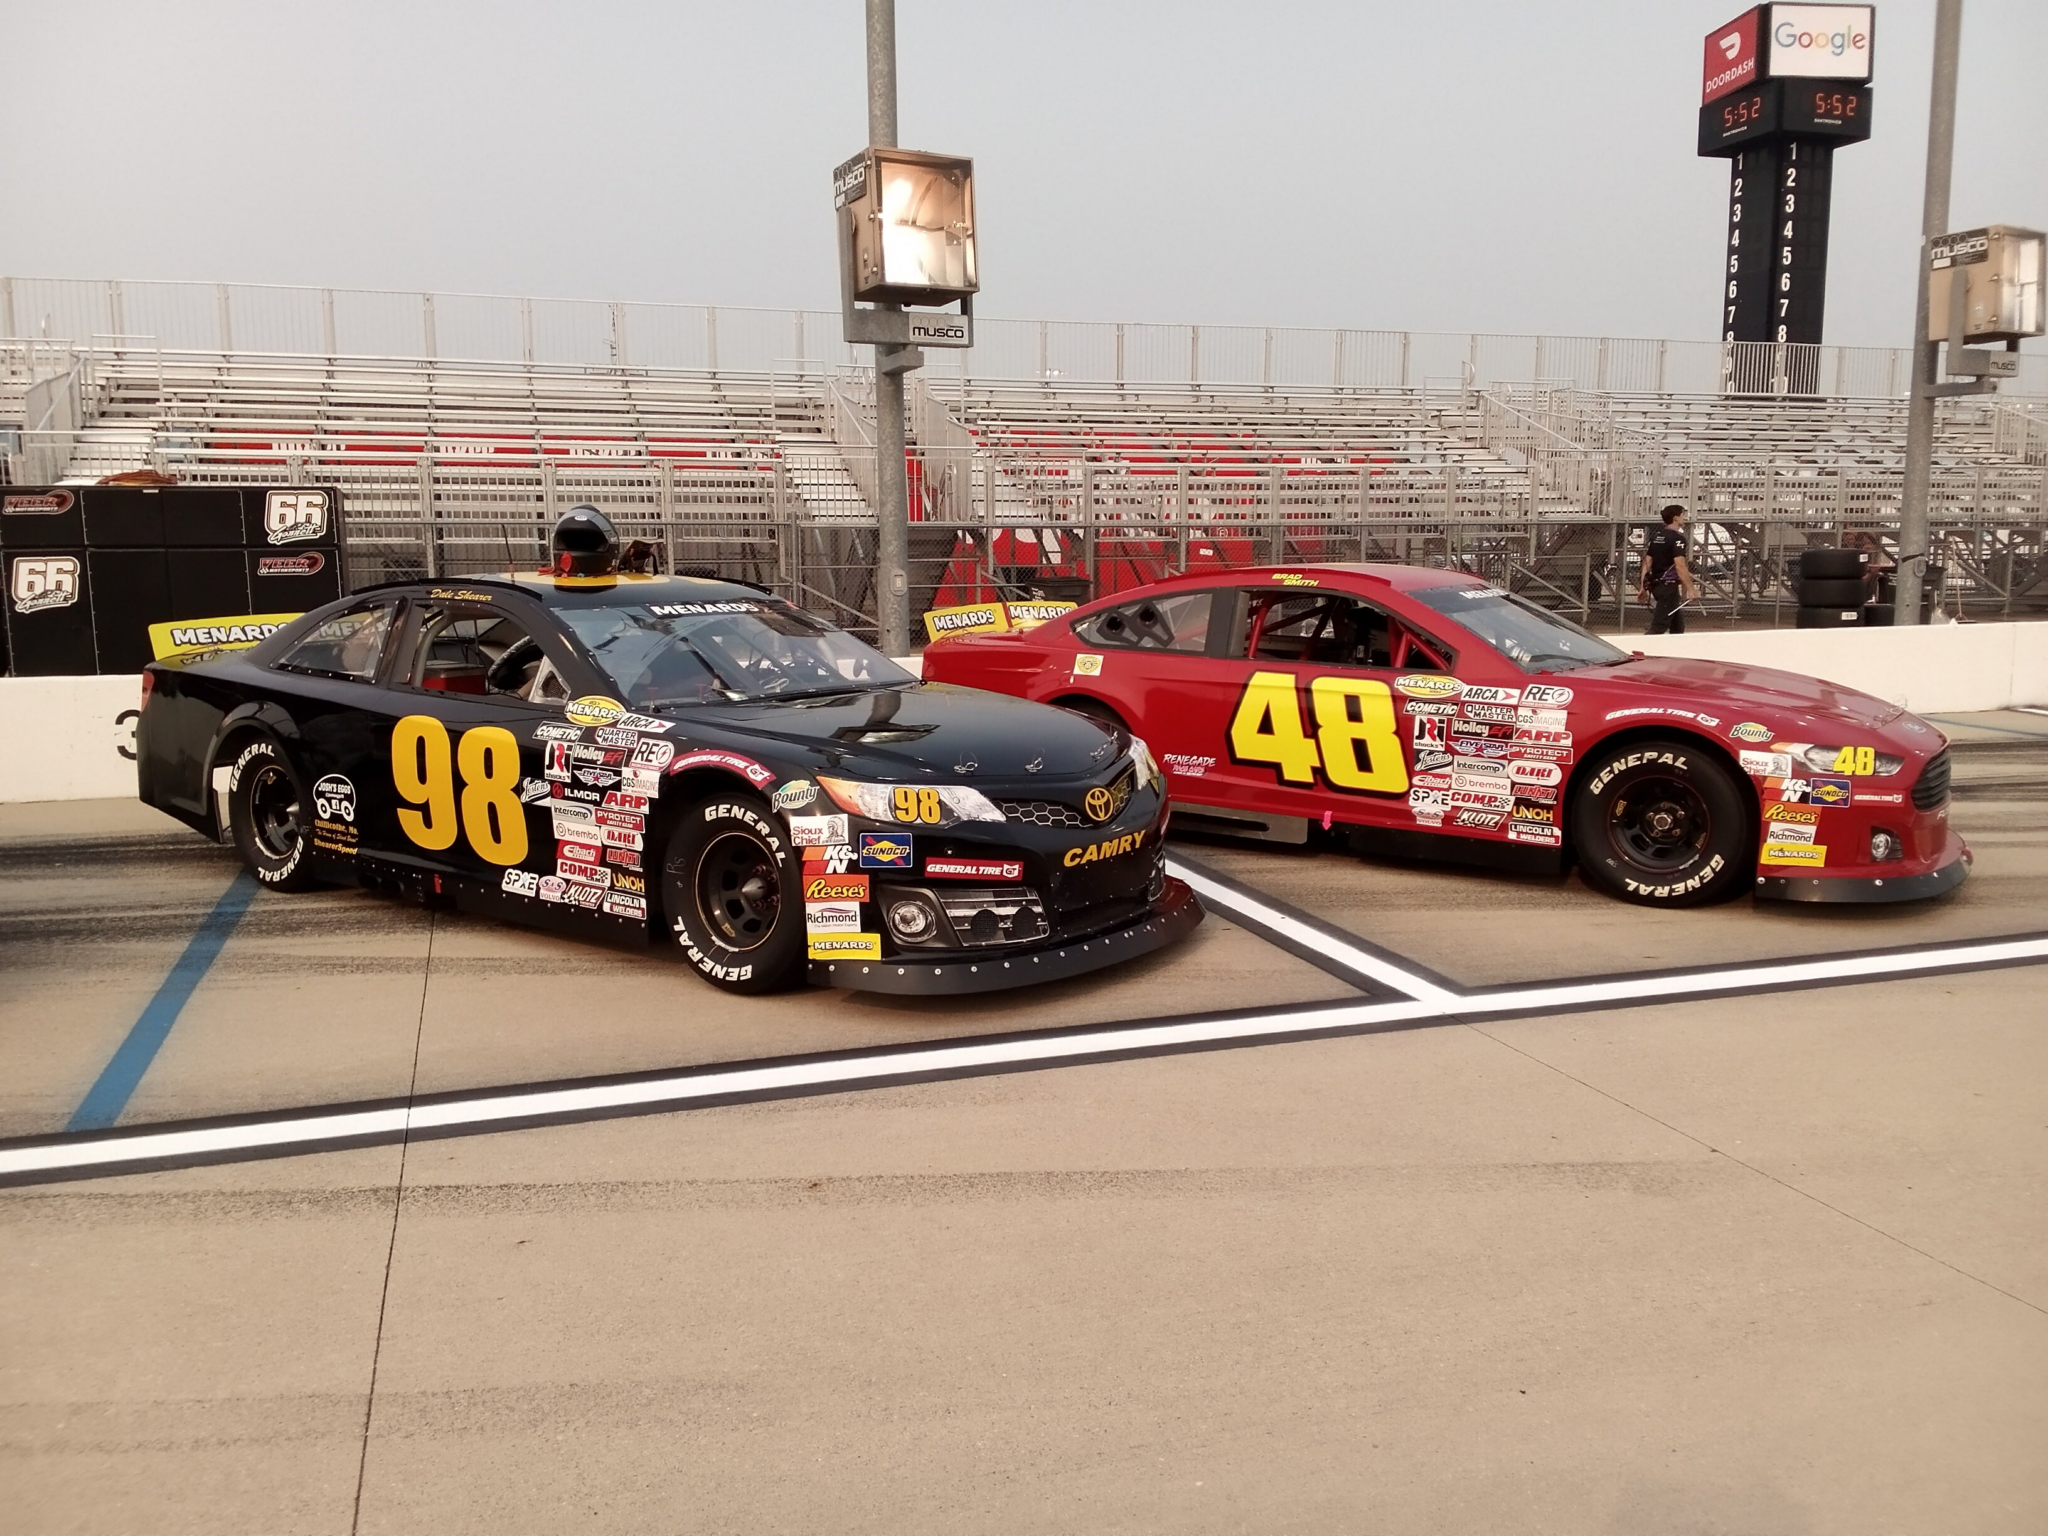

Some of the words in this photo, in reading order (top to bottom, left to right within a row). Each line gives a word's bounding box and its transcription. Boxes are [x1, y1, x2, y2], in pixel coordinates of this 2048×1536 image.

[1774, 21, 1866, 56] Google
[1706, 57, 1754, 93] DOORDASH
[1724, 97, 1761, 127] 5:52
[1816, 93, 1857, 116] 5:52
[1790, 142, 1797, 160] 1
[1736, 154, 1744, 170] 1
[1787, 168, 1796, 186] 2
[1734, 179, 1743, 197] 2
[1785, 194, 1795, 212] 3
[1733, 204, 1741, 222] 3
[1784, 220, 1793, 239] 4
[1731, 229, 1740, 247] 4
[1782, 246, 1792, 265] 5
[1730, 255, 1738, 273] 5
[1729, 280, 1737, 298] 6
[1781, 273, 1790, 291] 6
[1727, 306, 1735, 323] 7
[1780, 299, 1789, 317] 7
[1778, 325, 1787, 342] 8
[267, 492, 326, 531] 66
[15, 560, 77, 601] 66
[1283, 579, 1320, 587] SMITH
[430, 588, 454, 599] Dale
[454, 590, 493, 601] Shearer
[650, 600, 760, 617] MENARDS
[934, 610, 996, 632] MENARDS
[1396, 677, 1463, 691] MENARDS
[1463, 687, 1499, 701] ARCA
[566, 701, 625, 720] MENARDS
[1406, 702, 1457, 715] COMETIC
[1465, 704, 1512, 715] QUARTER
[1473, 712, 1514, 720] MASTER
[1605, 707, 1664, 721] GENERAL
[1666, 708, 1696, 719] TIRE
[619, 714, 654, 730] ARCA
[1454, 720, 1489, 739] Holley
[536, 725, 581, 741] COMETIC
[596, 728, 637, 740] QUARTER
[1231, 671, 1410, 794] 48
[1514, 729, 1571, 743] ARP
[1730, 725, 1775, 742] Bounty
[602, 736, 636, 747] MASTER
[574, 743, 605, 764] Holley
[1512, 746, 1569, 757] PYROTECT
[230, 743, 275, 792] GENERAL
[721, 755, 746, 769] TIRE
[1163, 753, 1217, 768] RENEGADE
[1456, 760, 1501, 773] Intercomp
[1742, 757, 1769, 767] Sioux
[1833, 746, 1875, 776] 48
[318, 782, 337, 793] JOSH'S
[337, 784, 351, 795] EGGS
[391, 714, 529, 866] 98
[1468, 778, 1508, 791] brembo
[1814, 788, 1848, 797] SUNOCO
[564, 787, 600, 802] ILMOR
[604, 791, 648, 809] ARP
[772, 785, 819, 813] Bounty
[1451, 791, 1498, 805] COMP
[1781, 791, 1802, 803] N
[553, 805, 589, 820] Intercomp
[893, 787, 942, 824] 98
[1512, 805, 1553, 821] UNOH
[1765, 804, 1818, 823] Reese's
[597, 811, 641, 824] PYROTECT
[1460, 811, 1500, 827] KLOTZ
[567, 827, 599, 841] brembo
[704, 804, 787, 868] GENERAL
[792, 825, 823, 836] Sioux
[1512, 824, 1553, 836] LINCOLN
[1769, 830, 1812, 843] Richmond
[314, 838, 358, 855] ShearerSpeed
[792, 835, 822, 846] Chief
[1520, 833, 1556, 844] WELDERS
[864, 846, 910, 857] SUNOCO
[1063, 829, 1147, 868] CAMRY
[1769, 850, 1819, 859] MENARDS
[257, 835, 304, 882] GENERAL
[559, 861, 598, 879] COMP
[826, 860, 848, 874] N
[926, 863, 977, 875] GENERAL
[977, 866, 1002, 876] TIRE
[612, 872, 645, 893] UNOH
[1624, 853, 1725, 898] GENERAL
[540, 892, 561, 901] VOLVO
[567, 884, 603, 904] KLOTZ
[806, 879, 866, 899] Reese's
[606, 892, 641, 908] LINCOLN
[612, 906, 643, 918] WELDERS
[807, 911, 858, 924] Richmond
[673, 915, 753, 982] GENERAL
[813, 941, 874, 950] MENARDS
